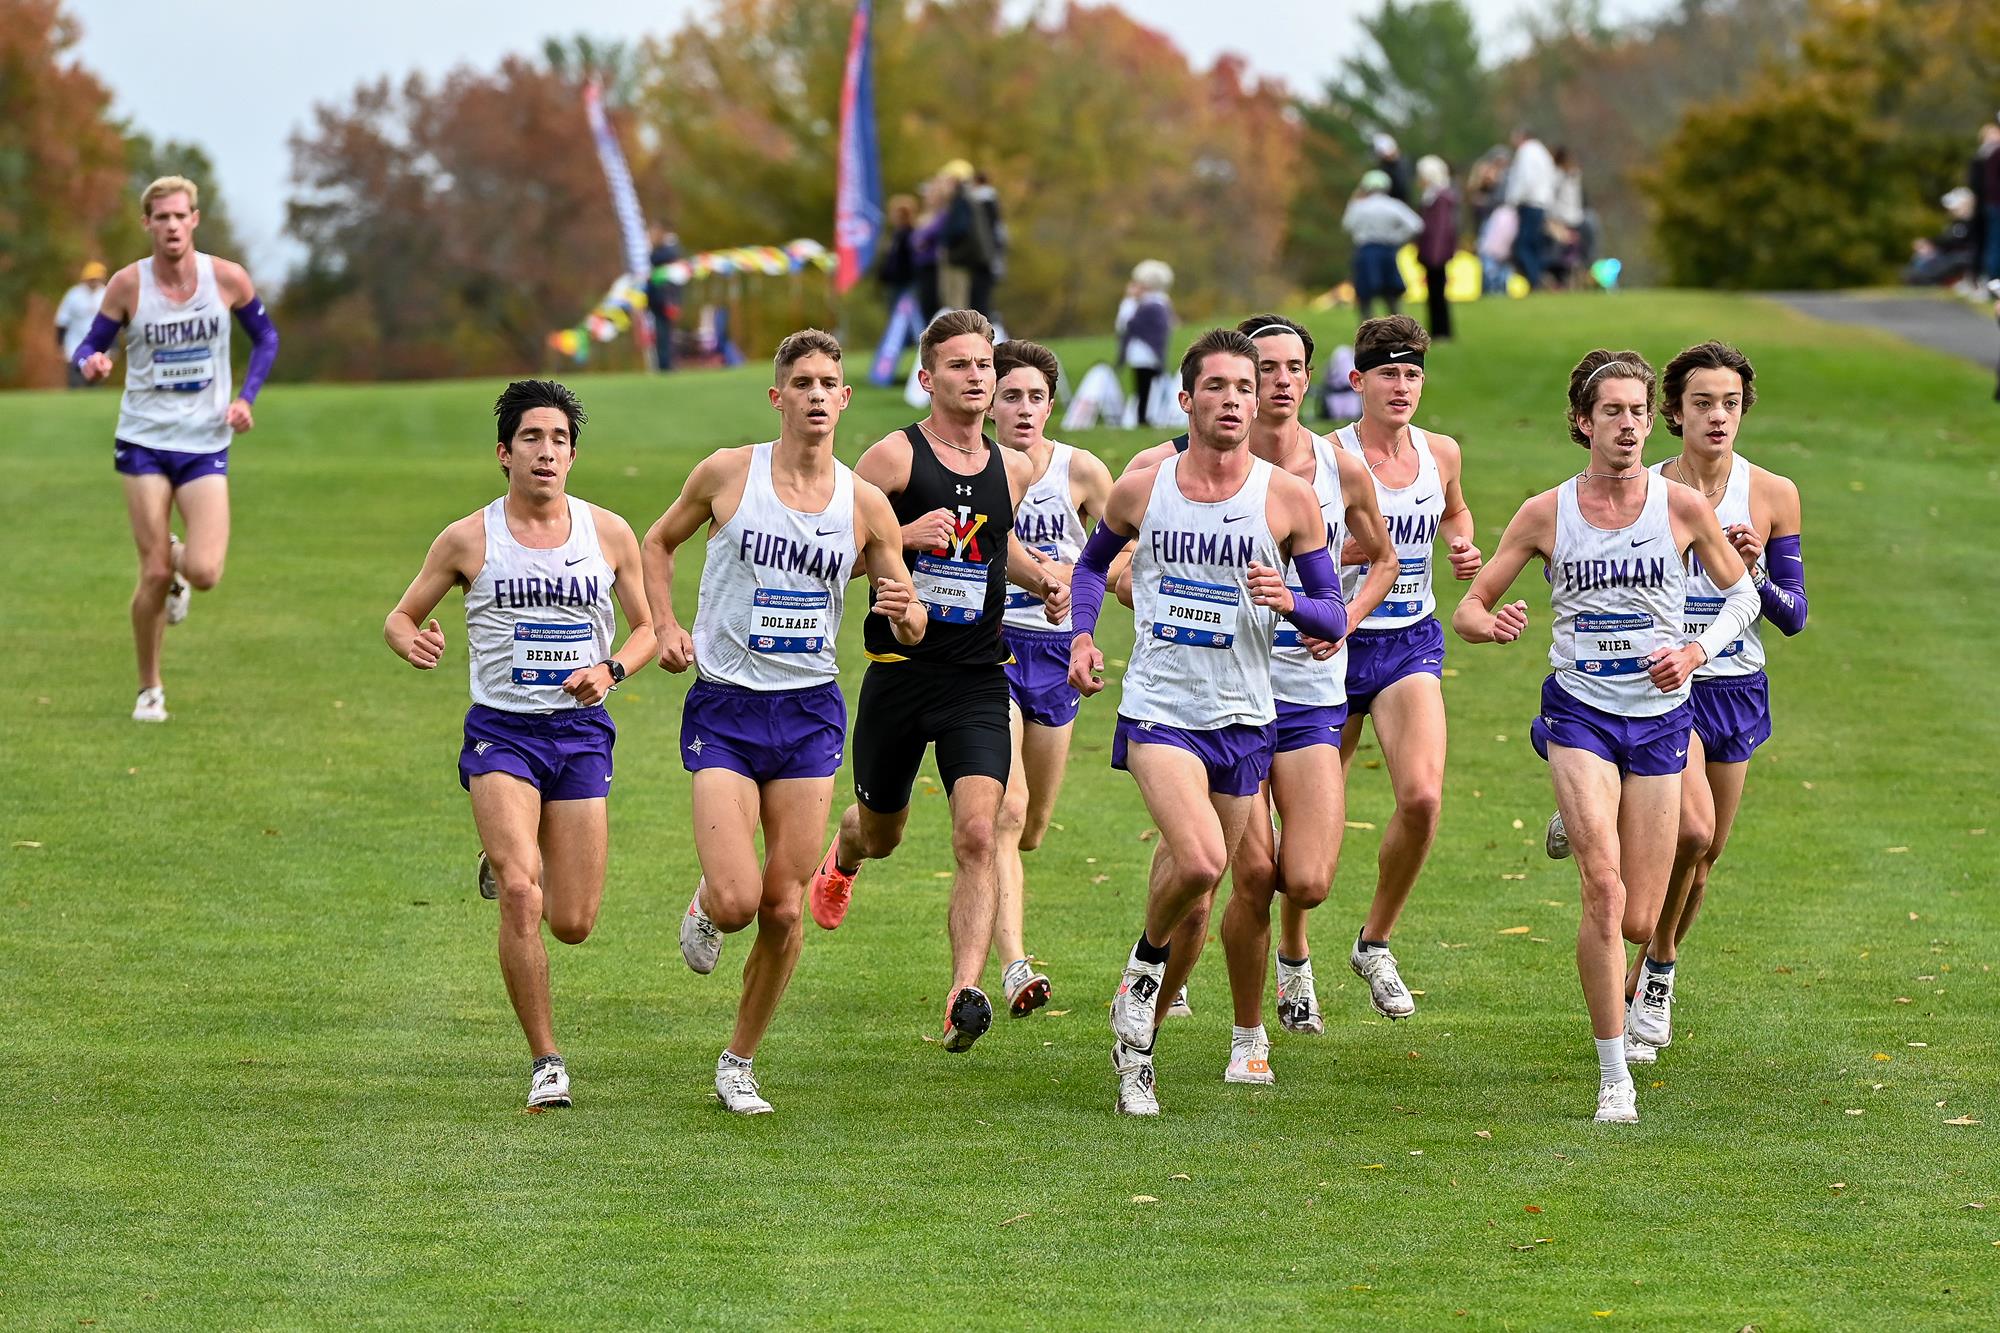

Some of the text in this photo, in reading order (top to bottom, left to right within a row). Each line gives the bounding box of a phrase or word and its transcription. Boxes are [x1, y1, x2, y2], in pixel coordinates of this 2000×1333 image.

[145, 317, 219, 344] FURMAN
[1014, 514, 1064, 542] MAN
[1383, 514, 1439, 544] RMAN
[740, 529, 844, 581] FURMAN
[1151, 530, 1254, 568] FURMAN
[1563, 557, 1664, 591] FURMAN
[494, 576, 598, 608] FURMAN
[931, 586, 967, 598] JENKINS
[1185, 585, 1210, 594] SOUTHERN
[1210, 589, 1239, 598] CONFERENCE
[761, 616, 818, 629] DOLHARE
[1168, 605, 1222, 625] PONDER
[526, 650, 579, 661] BERNAL
[1597, 640, 1631, 651] WIER
